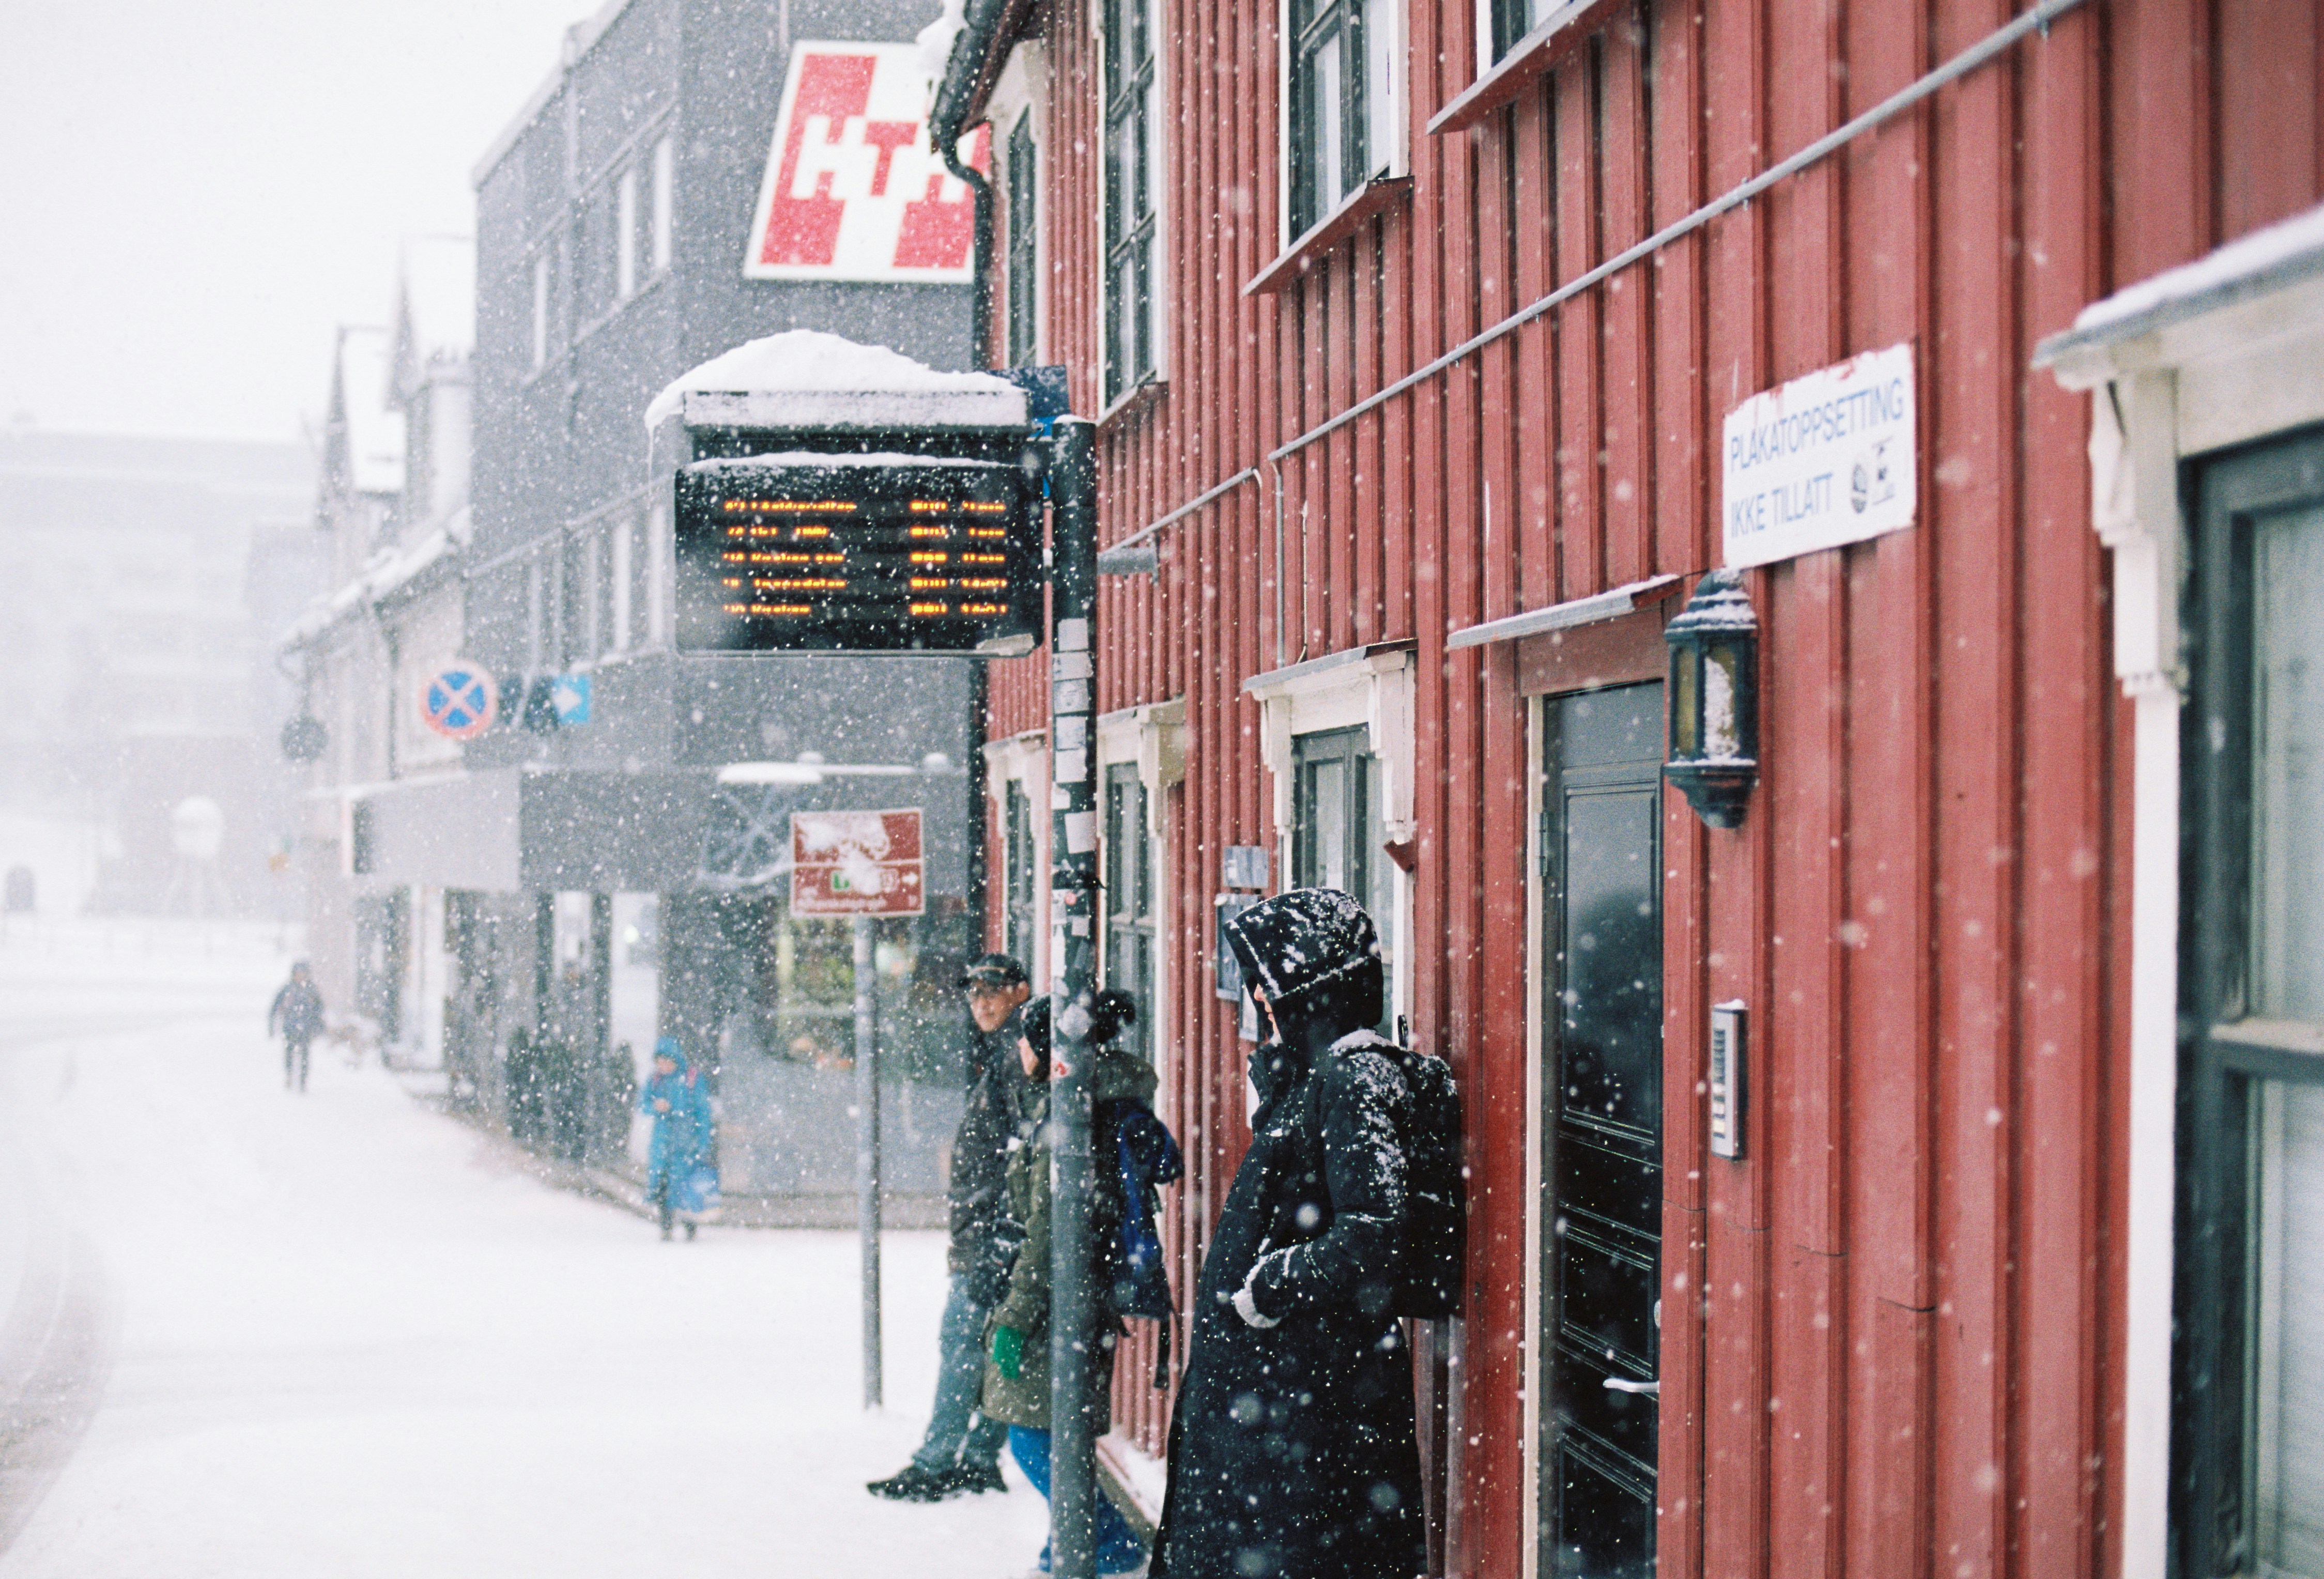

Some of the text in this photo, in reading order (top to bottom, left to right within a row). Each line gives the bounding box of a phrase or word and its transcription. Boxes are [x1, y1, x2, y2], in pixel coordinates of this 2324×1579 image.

[1731, 377, 1903, 473] PLAKATOPPSETTING
[1731, 472, 1834, 538] IKKE TILLATT
